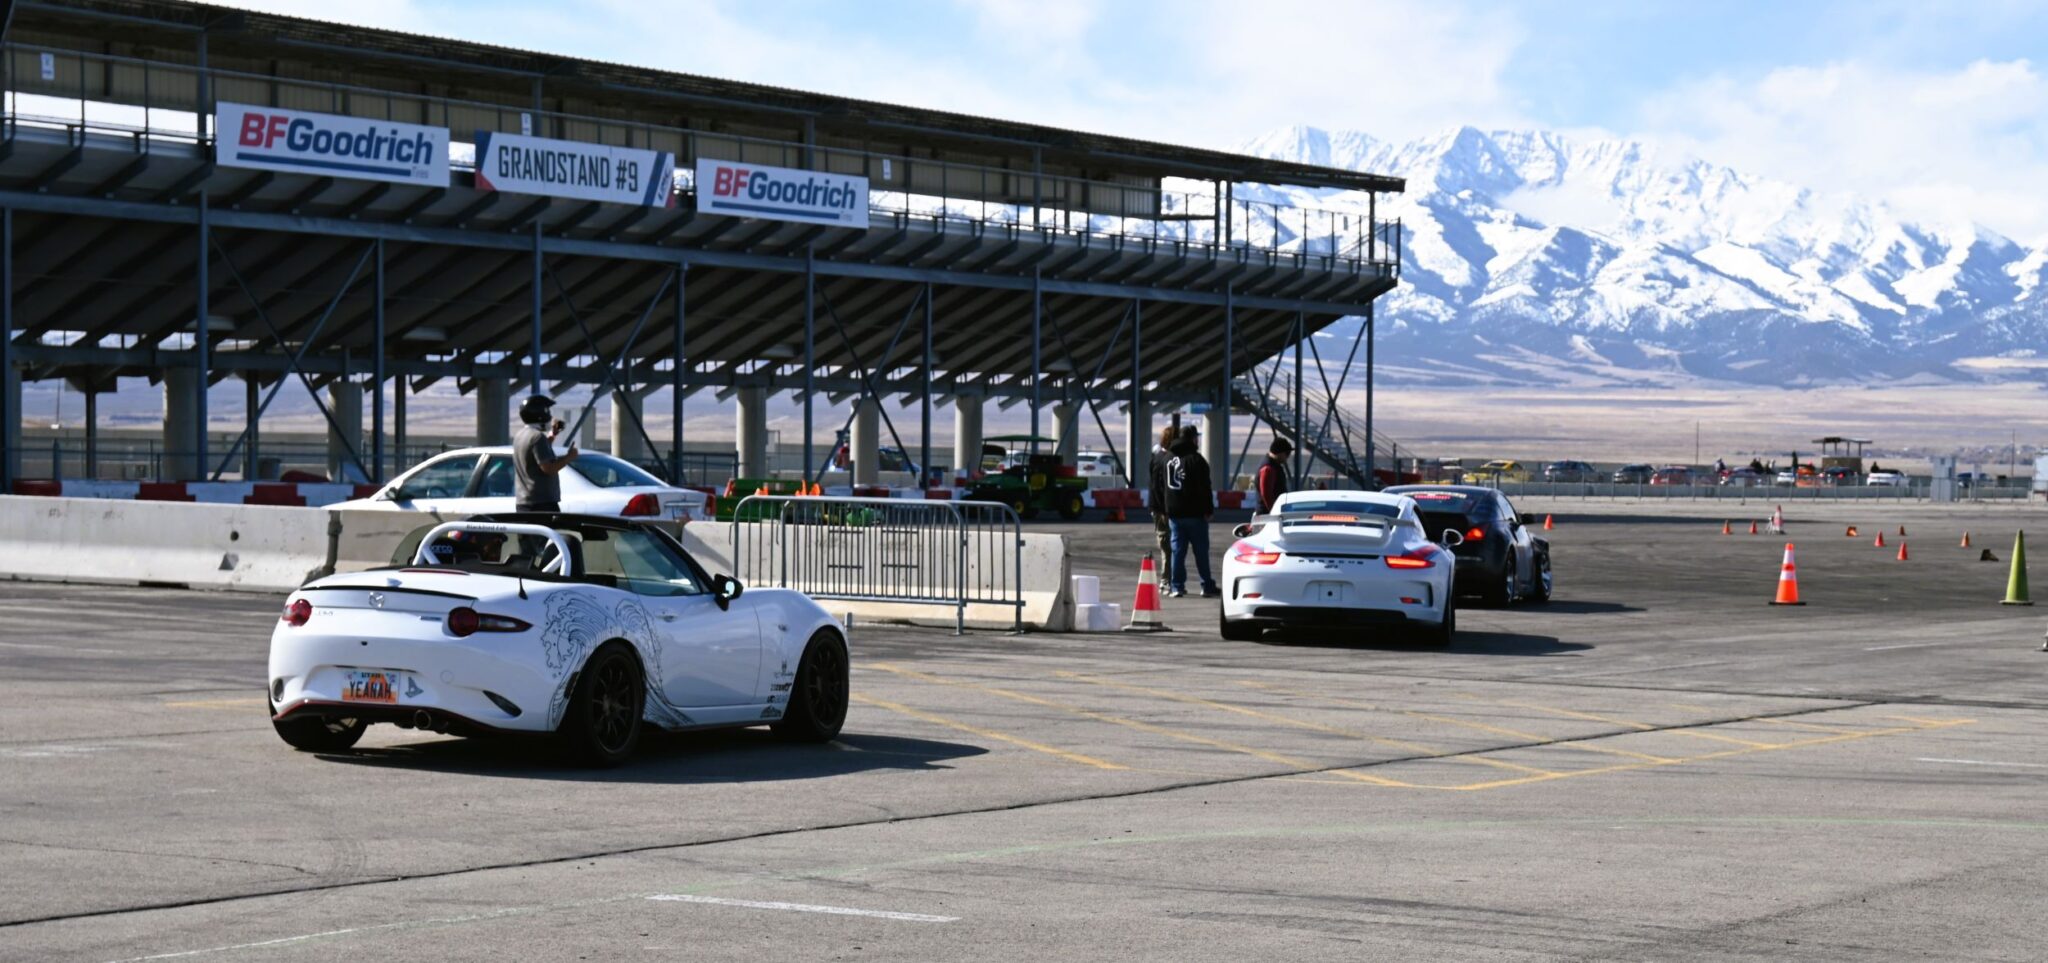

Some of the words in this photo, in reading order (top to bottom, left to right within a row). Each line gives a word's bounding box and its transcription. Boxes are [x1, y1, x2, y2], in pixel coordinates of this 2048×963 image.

[238, 111, 433, 165] BFGoodrich
[498, 145, 610, 188] GRANDSTAND
[615, 159, 638, 192] #9
[712, 156, 857, 209] BFGoodrich
